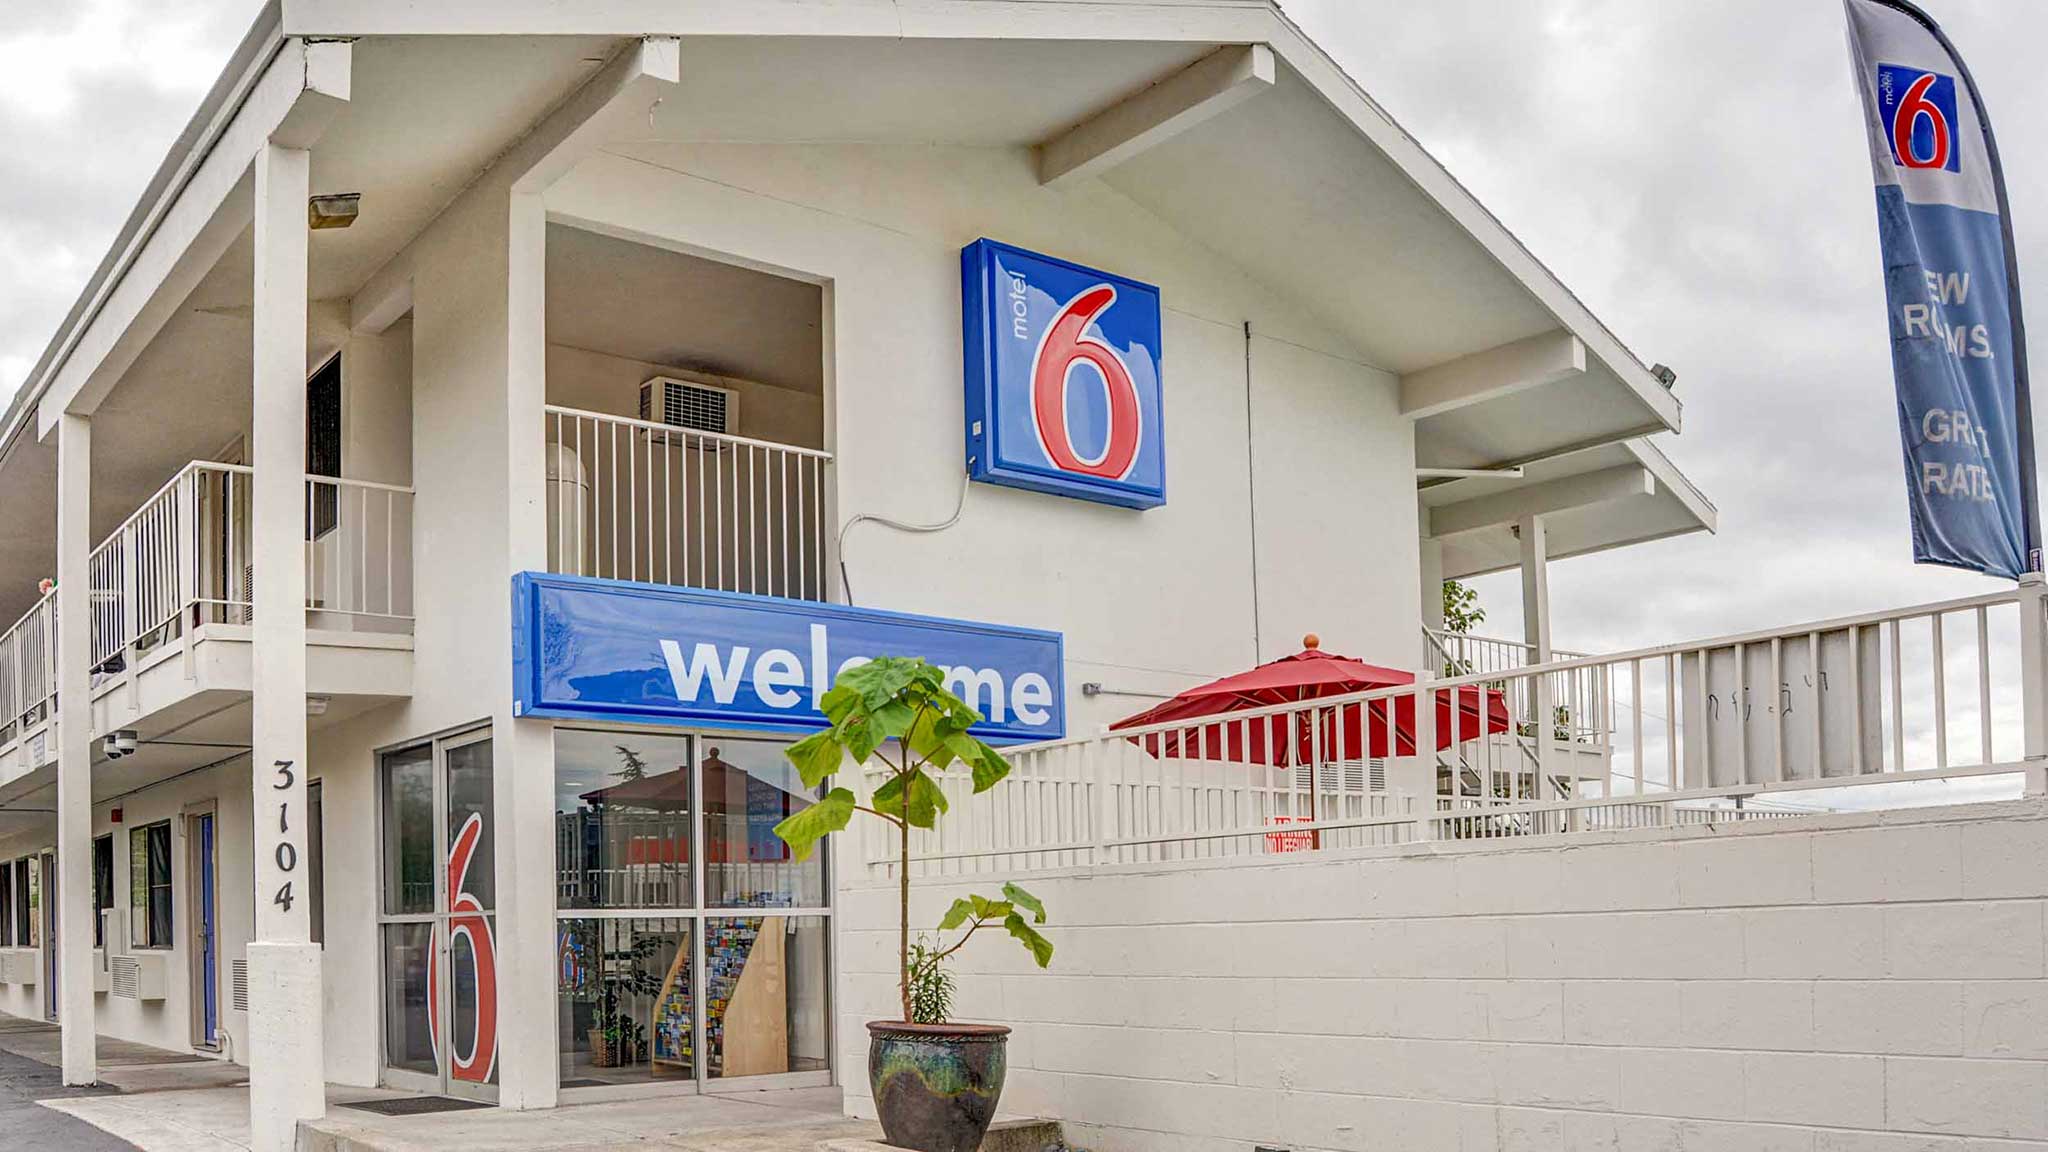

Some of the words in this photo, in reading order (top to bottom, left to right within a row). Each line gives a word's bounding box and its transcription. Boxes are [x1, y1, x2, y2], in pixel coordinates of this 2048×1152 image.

[1893, 73, 1951, 170] 6
[1008, 270, 1029, 340] motel
[1903, 303, 1995, 359] RMS.
[1922, 270, 1970, 305] EW
[1030, 282, 1143, 482] 6
[659, 623, 1053, 727] welme
[273, 760, 297, 913] 3104
[427, 811, 498, 1083] 6
